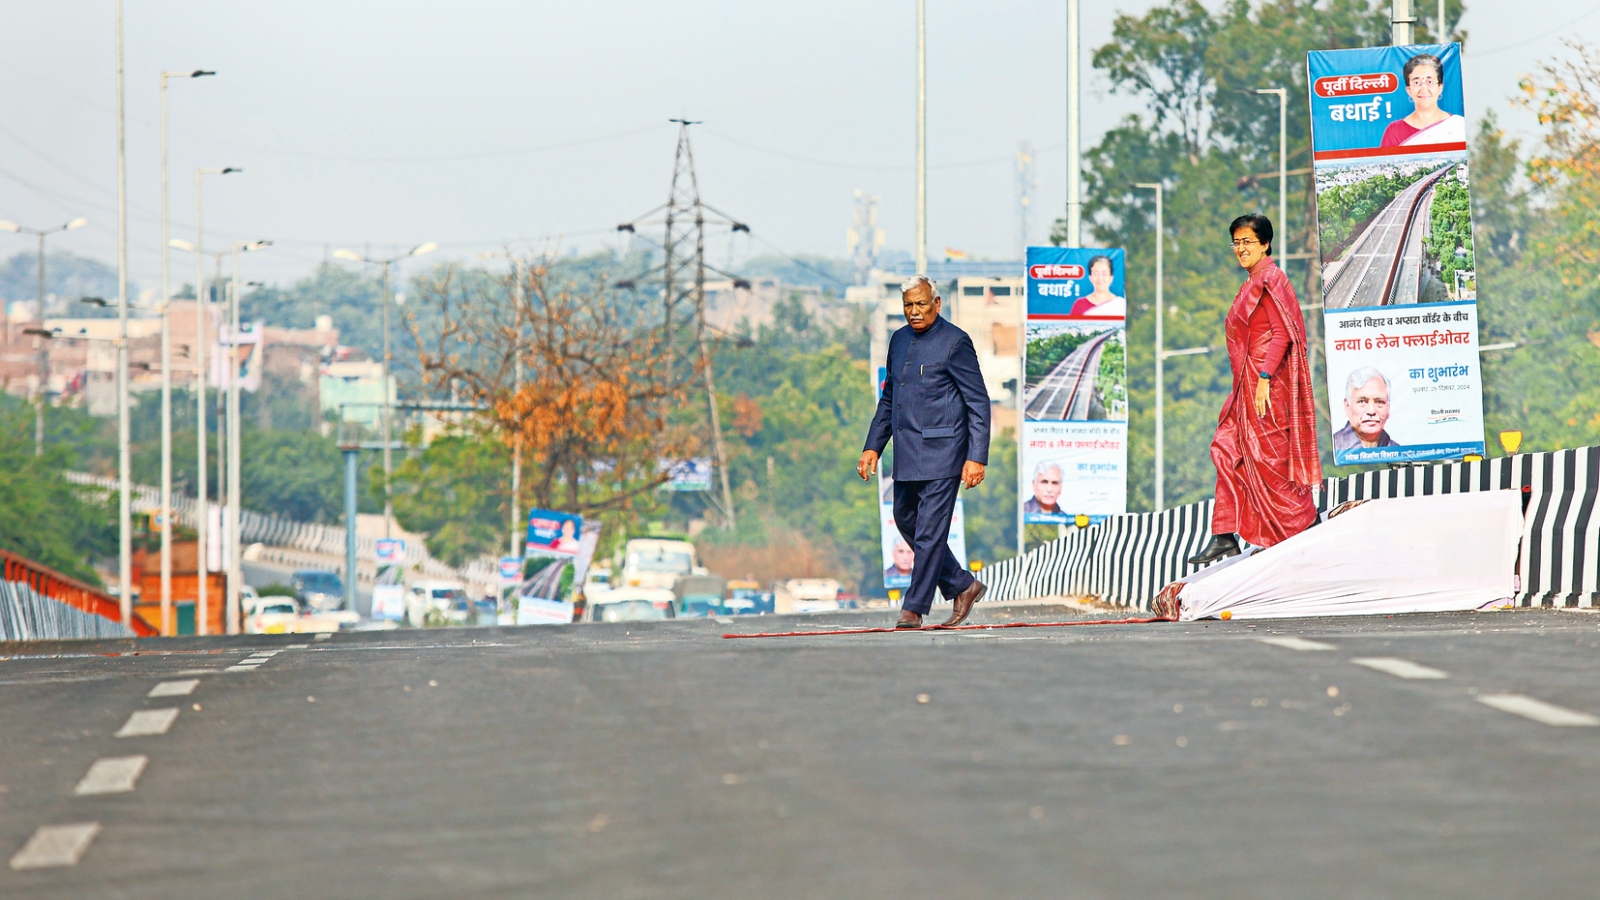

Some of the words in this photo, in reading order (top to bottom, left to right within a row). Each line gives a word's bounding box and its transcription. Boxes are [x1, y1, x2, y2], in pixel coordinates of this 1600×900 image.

[1322, 77, 1348, 96] पूर्वी
[1349, 74, 1390, 91] दिल्ली
[1328, 96, 1382, 122] बधाई
[1037, 280, 1074, 298] बधाई
[1339, 317, 1361, 328] आनंद
[1364, 316, 1385, 327] विहार
[1387, 317, 1393, 325] व
[1395, 315, 1420, 325] अप्सरा
[1442, 311, 1451, 322] के
[1334, 339, 1361, 351] नया
[1364, 338, 1373, 350] 6
[1375, 333, 1400, 348] लेन
[1402, 329, 1470, 347] फ्लाईओवर
[1408, 368, 1425, 379] का
[1428, 363, 1469, 383] शुभारंभ
